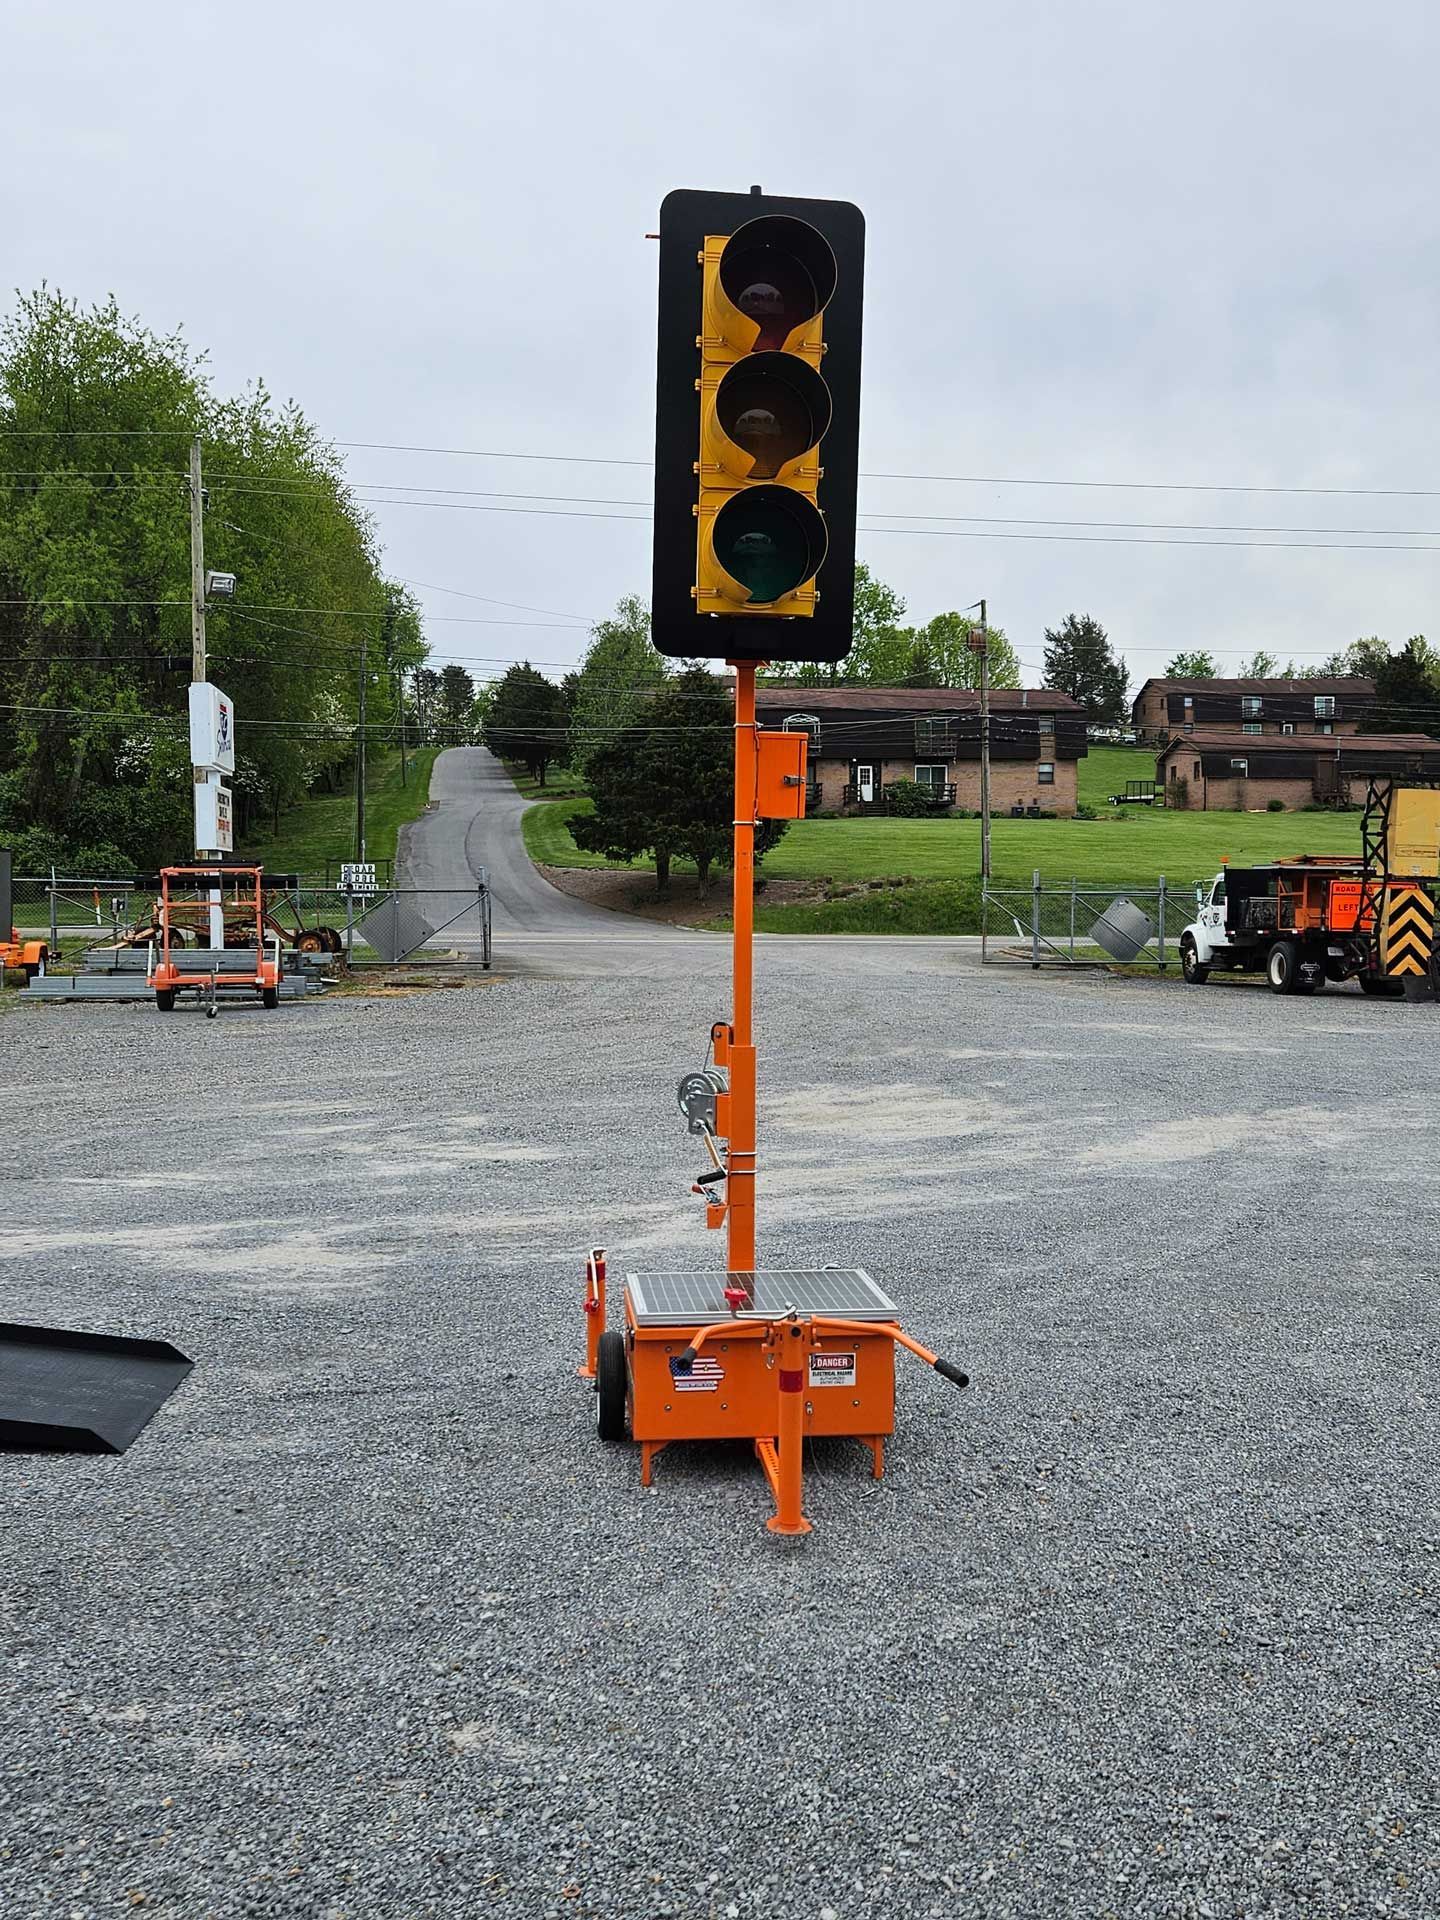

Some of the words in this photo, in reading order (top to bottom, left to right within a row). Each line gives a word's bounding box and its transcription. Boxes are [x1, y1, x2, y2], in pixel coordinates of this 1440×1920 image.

[343, 865, 373, 873] CDAR
[1338, 904, 1359, 912] LEFT
[817, 1358, 848, 1367] DANGER
